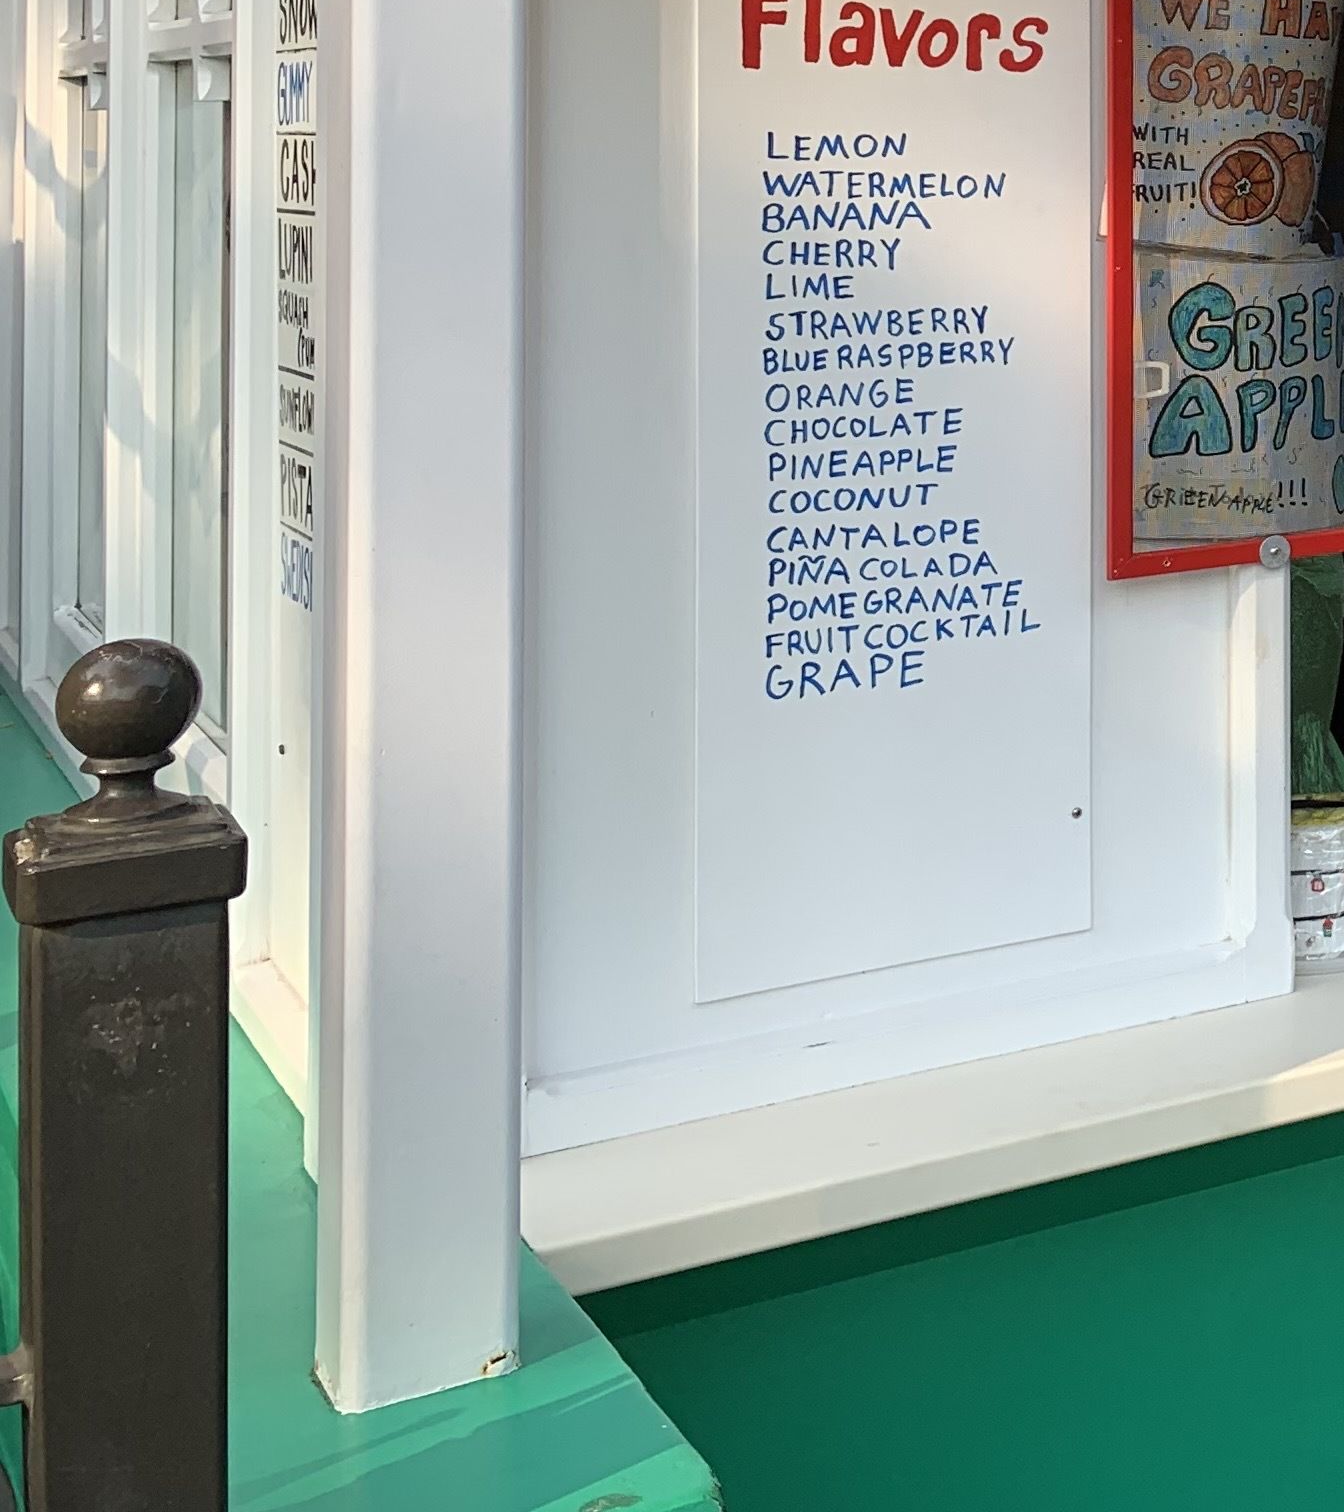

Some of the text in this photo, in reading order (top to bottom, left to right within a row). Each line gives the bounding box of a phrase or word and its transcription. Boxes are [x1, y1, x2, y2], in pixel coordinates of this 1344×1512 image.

[767, 132, 907, 160] LEMON
[1132, 123, 1189, 146] WITH
[1133, 152, 1195, 172] REAL
[762, 170, 1006, 199] WATERMELON
[762, 200, 931, 233] BANANA
[762, 237, 900, 270] CHERRY
[766, 273, 854, 300] LIME
[765, 305, 988, 341] STRAWBERRY
[765, 377, 914, 412] ORANGE
[764, 407, 963, 446] CHOCOLATE
[769, 445, 957, 481] PINEAPPLE
[768, 484, 938, 514] COCONUT
[766, 519, 980, 554] CANTALOPE
[768, 551, 998, 587] PIÑA COLADA
[767, 580, 1022, 624] POMEGRANATE
[766, 650, 925, 699] GRAPE
